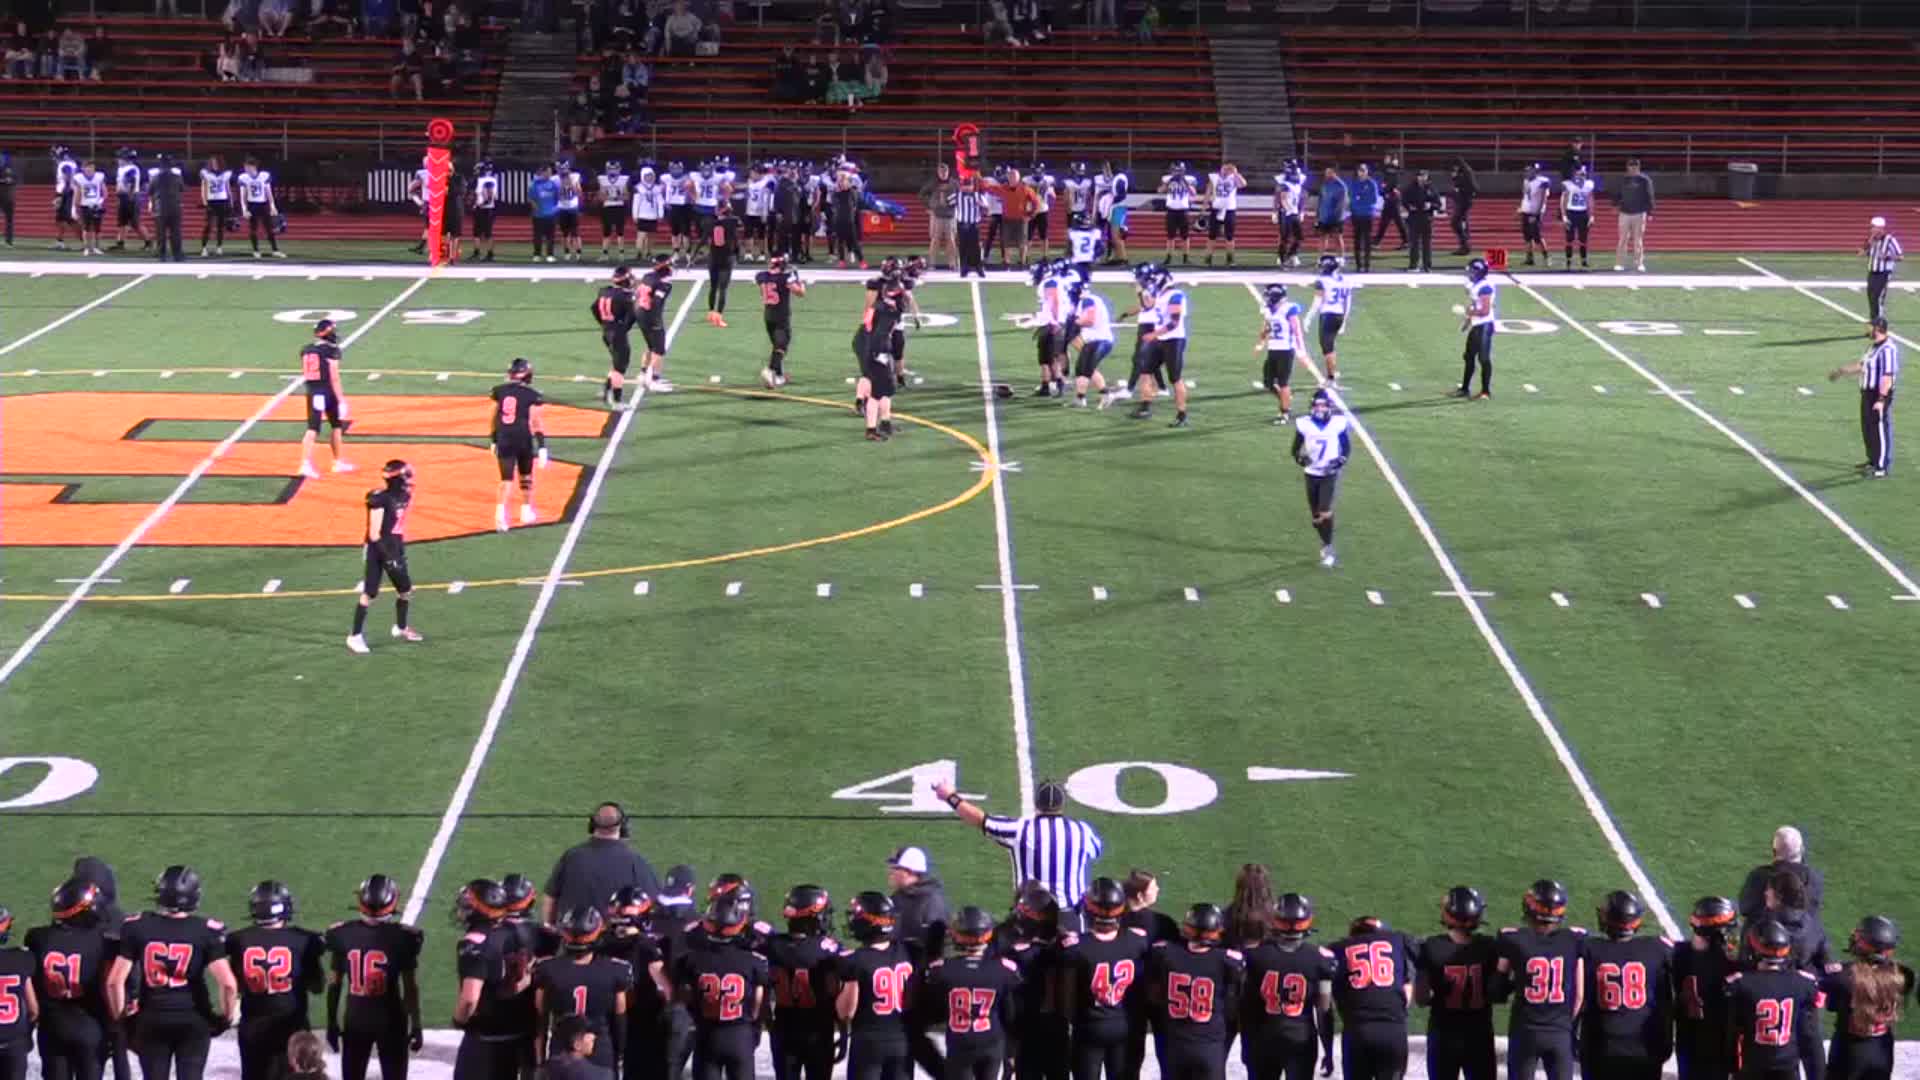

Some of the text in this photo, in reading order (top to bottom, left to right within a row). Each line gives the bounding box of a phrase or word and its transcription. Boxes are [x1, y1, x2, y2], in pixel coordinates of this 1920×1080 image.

[1080, 236, 1091, 254] 2
[501, 396, 517, 424] 9
[1315, 440, 1328, 460] 7
[44, 951, 83, 999] 61
[144, 942, 193, 988] 67
[243, 946, 292, 994] 62
[347, 949, 388, 996] 16
[1091, 959, 1136, 1006] 42
[1345, 941, 1394, 990] 56
[1444, 964, 1484, 1010] 71
[1524, 956, 1564, 1003] 31
[1597, 961, 1647, 1010] 68
[572, 985, 589, 1016] 1
[948, 987, 996, 1033] 87
[1168, 972, 1215, 1023] 58
[1260, 970, 1308, 1018] 43
[1755, 998, 1795, 1046] 21
